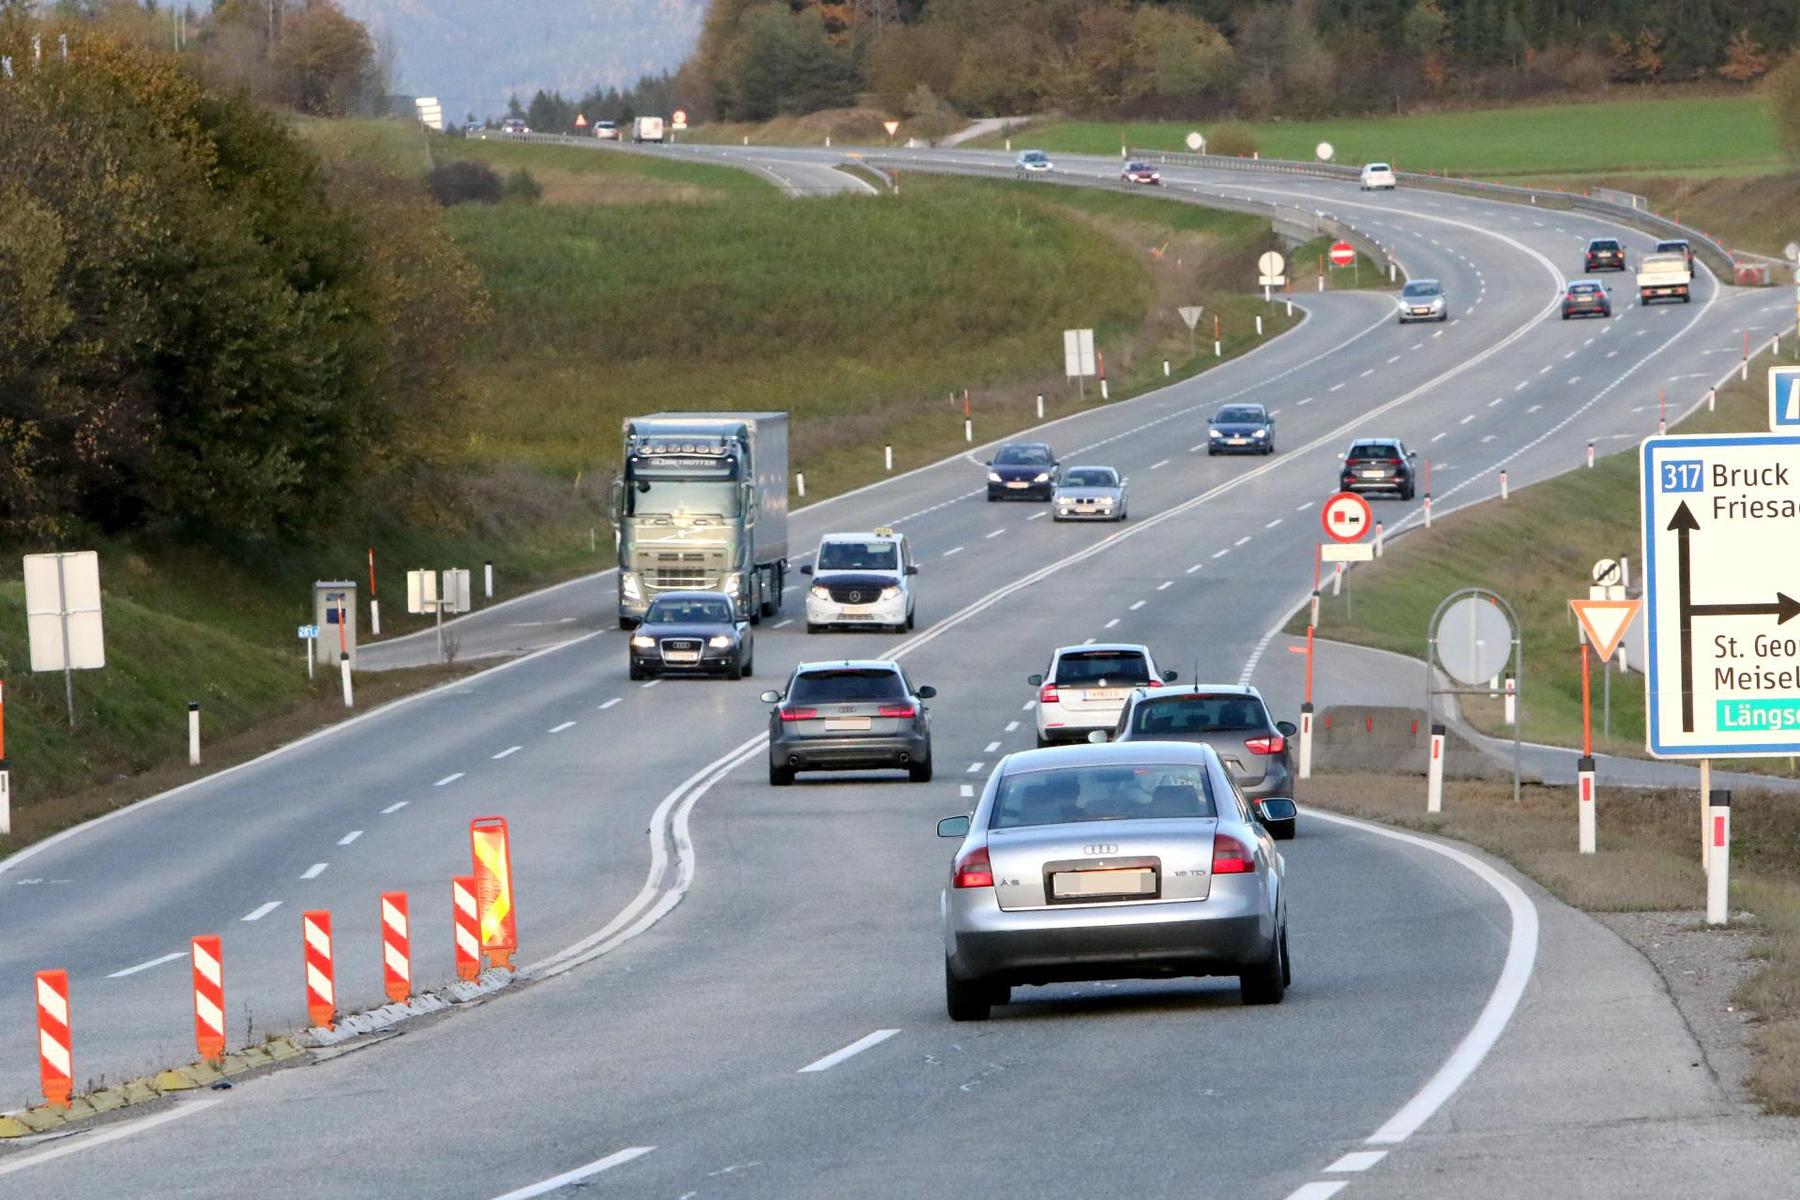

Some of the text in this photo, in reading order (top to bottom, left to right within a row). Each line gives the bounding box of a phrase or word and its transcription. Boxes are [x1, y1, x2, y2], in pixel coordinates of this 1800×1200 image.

[1664, 464, 1701, 489] 317
[1712, 462, 1790, 488] Bruck
[1713, 494, 1800, 519] Friesa
[1714, 633, 1800, 659] St. Geo
[1714, 665, 1800, 690] Meisel
